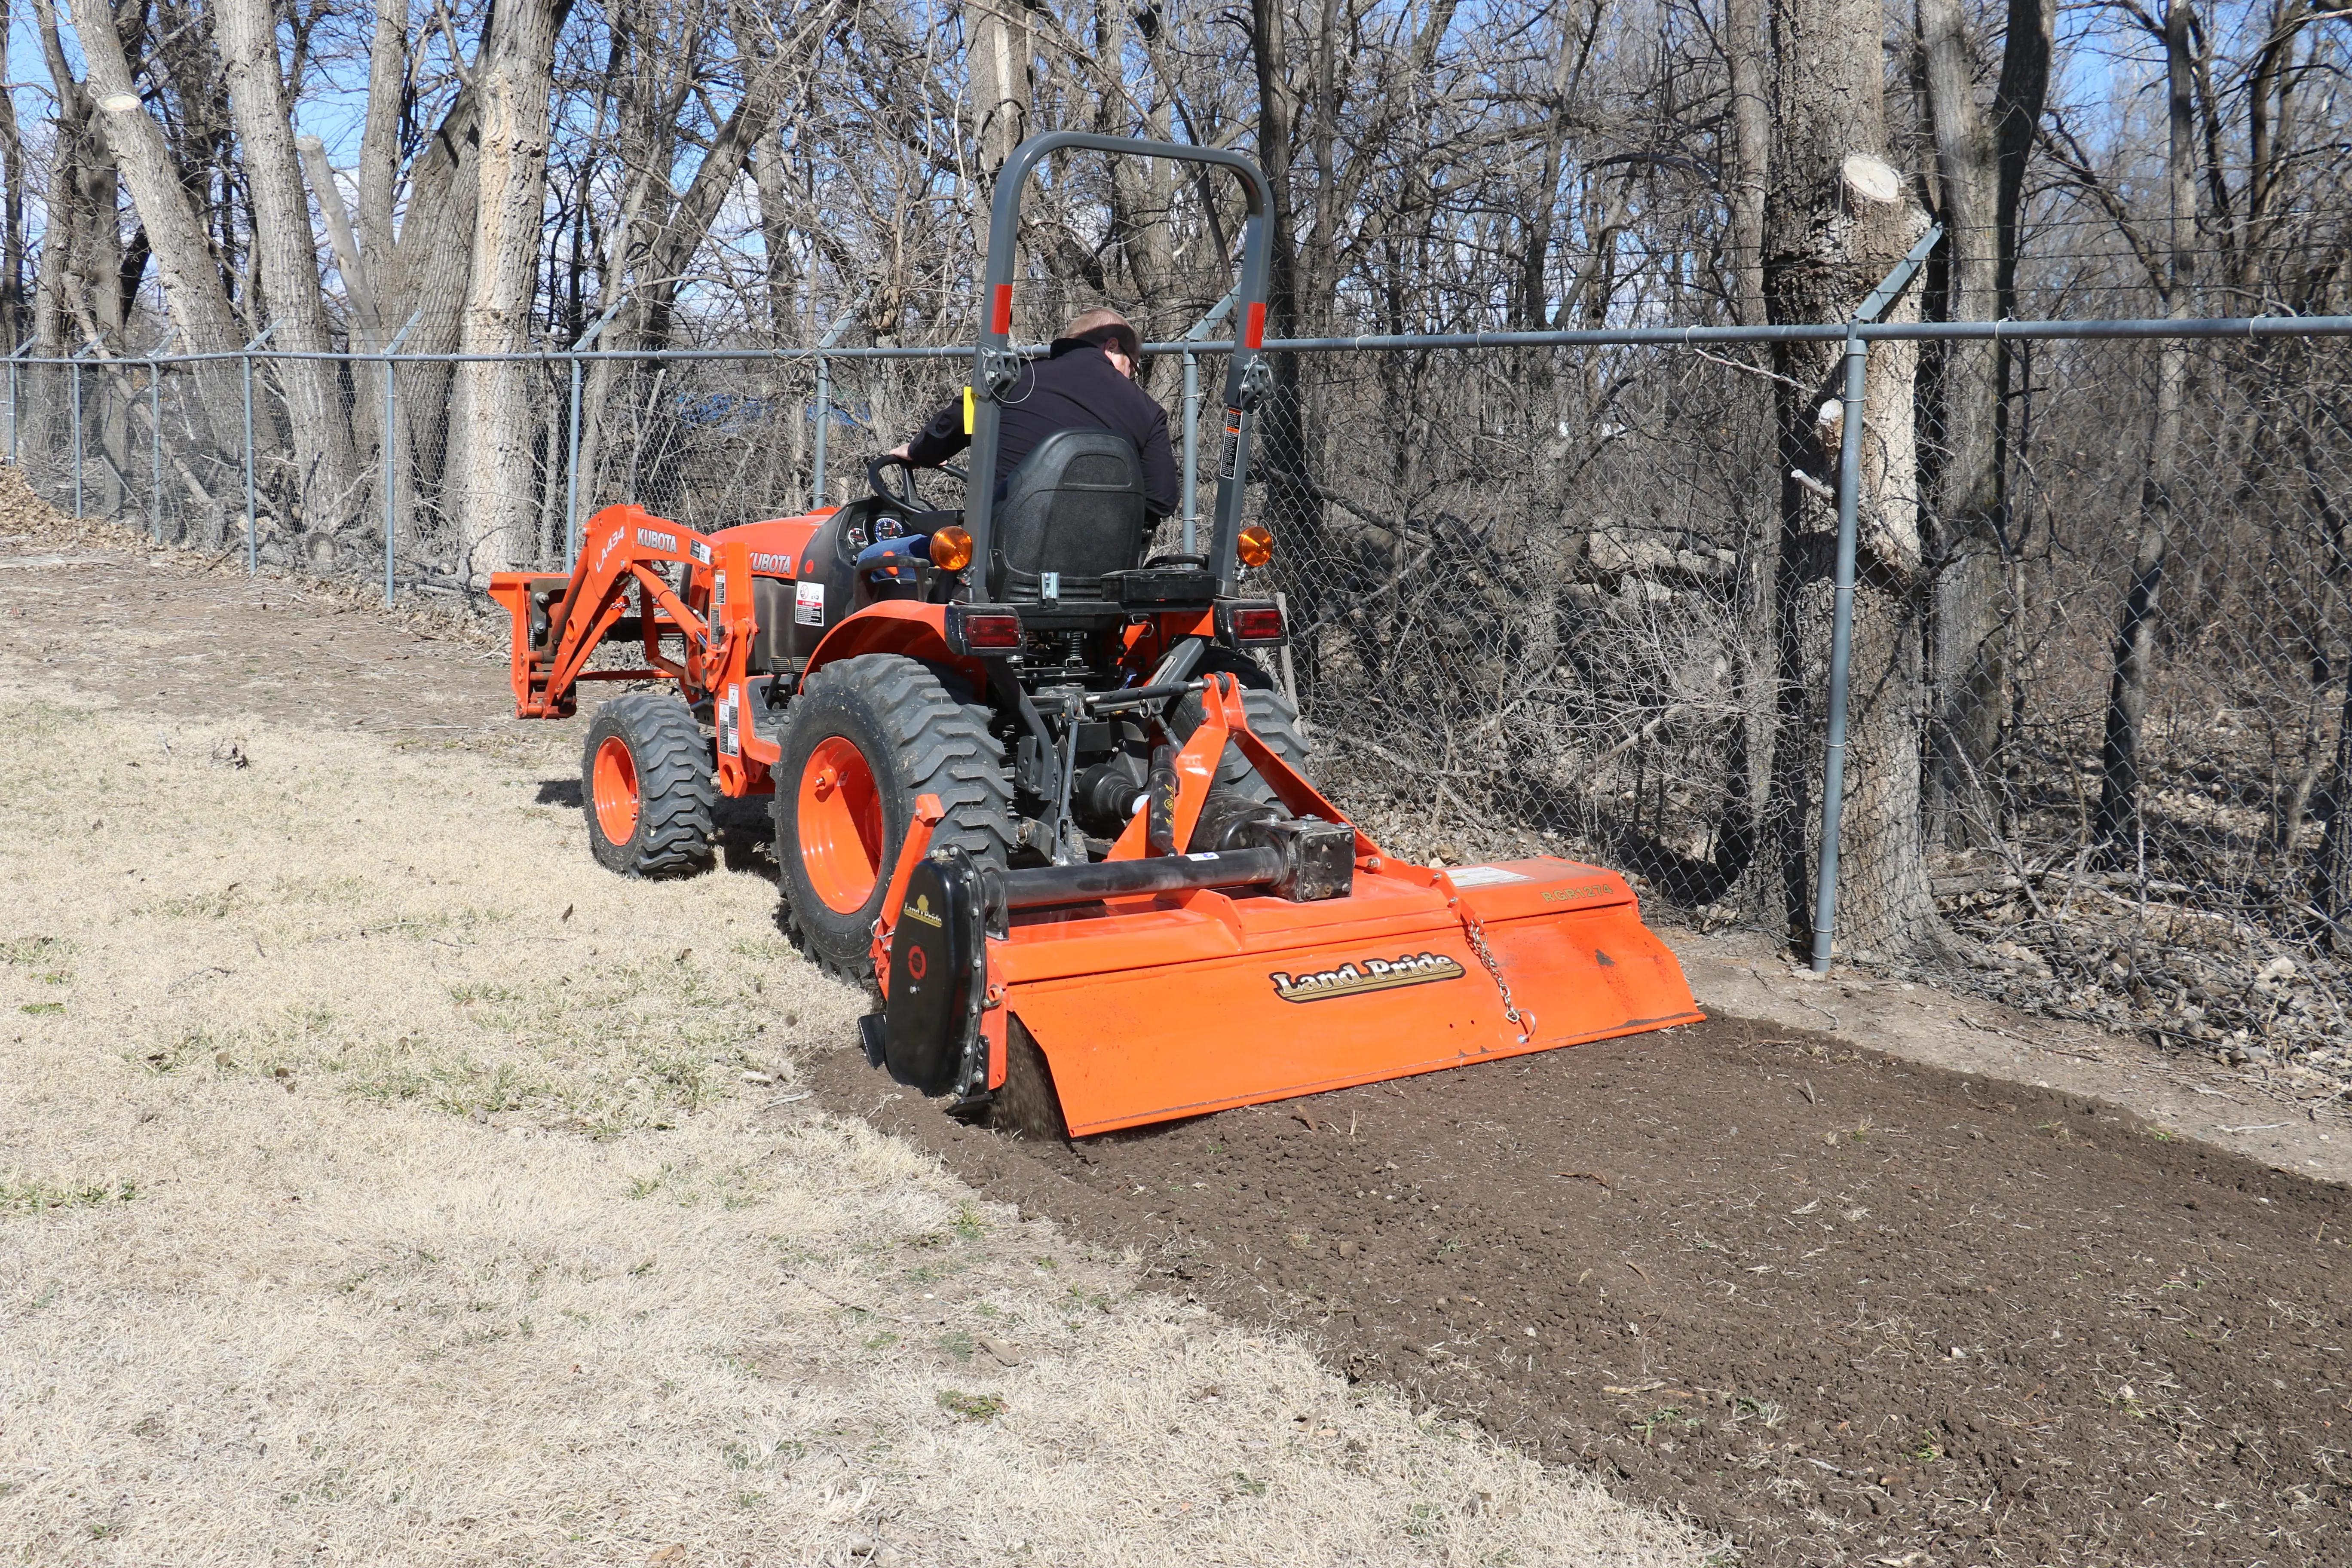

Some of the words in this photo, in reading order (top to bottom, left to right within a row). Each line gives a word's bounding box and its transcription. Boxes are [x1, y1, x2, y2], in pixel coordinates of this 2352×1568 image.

[595, 526, 624, 573] LA434
[637, 527, 677, 554] KUBOTA
[1540, 884, 1614, 903] RGR1274
[1273, 964, 1363, 994] Land
[1365, 953, 1455, 980] Pride
